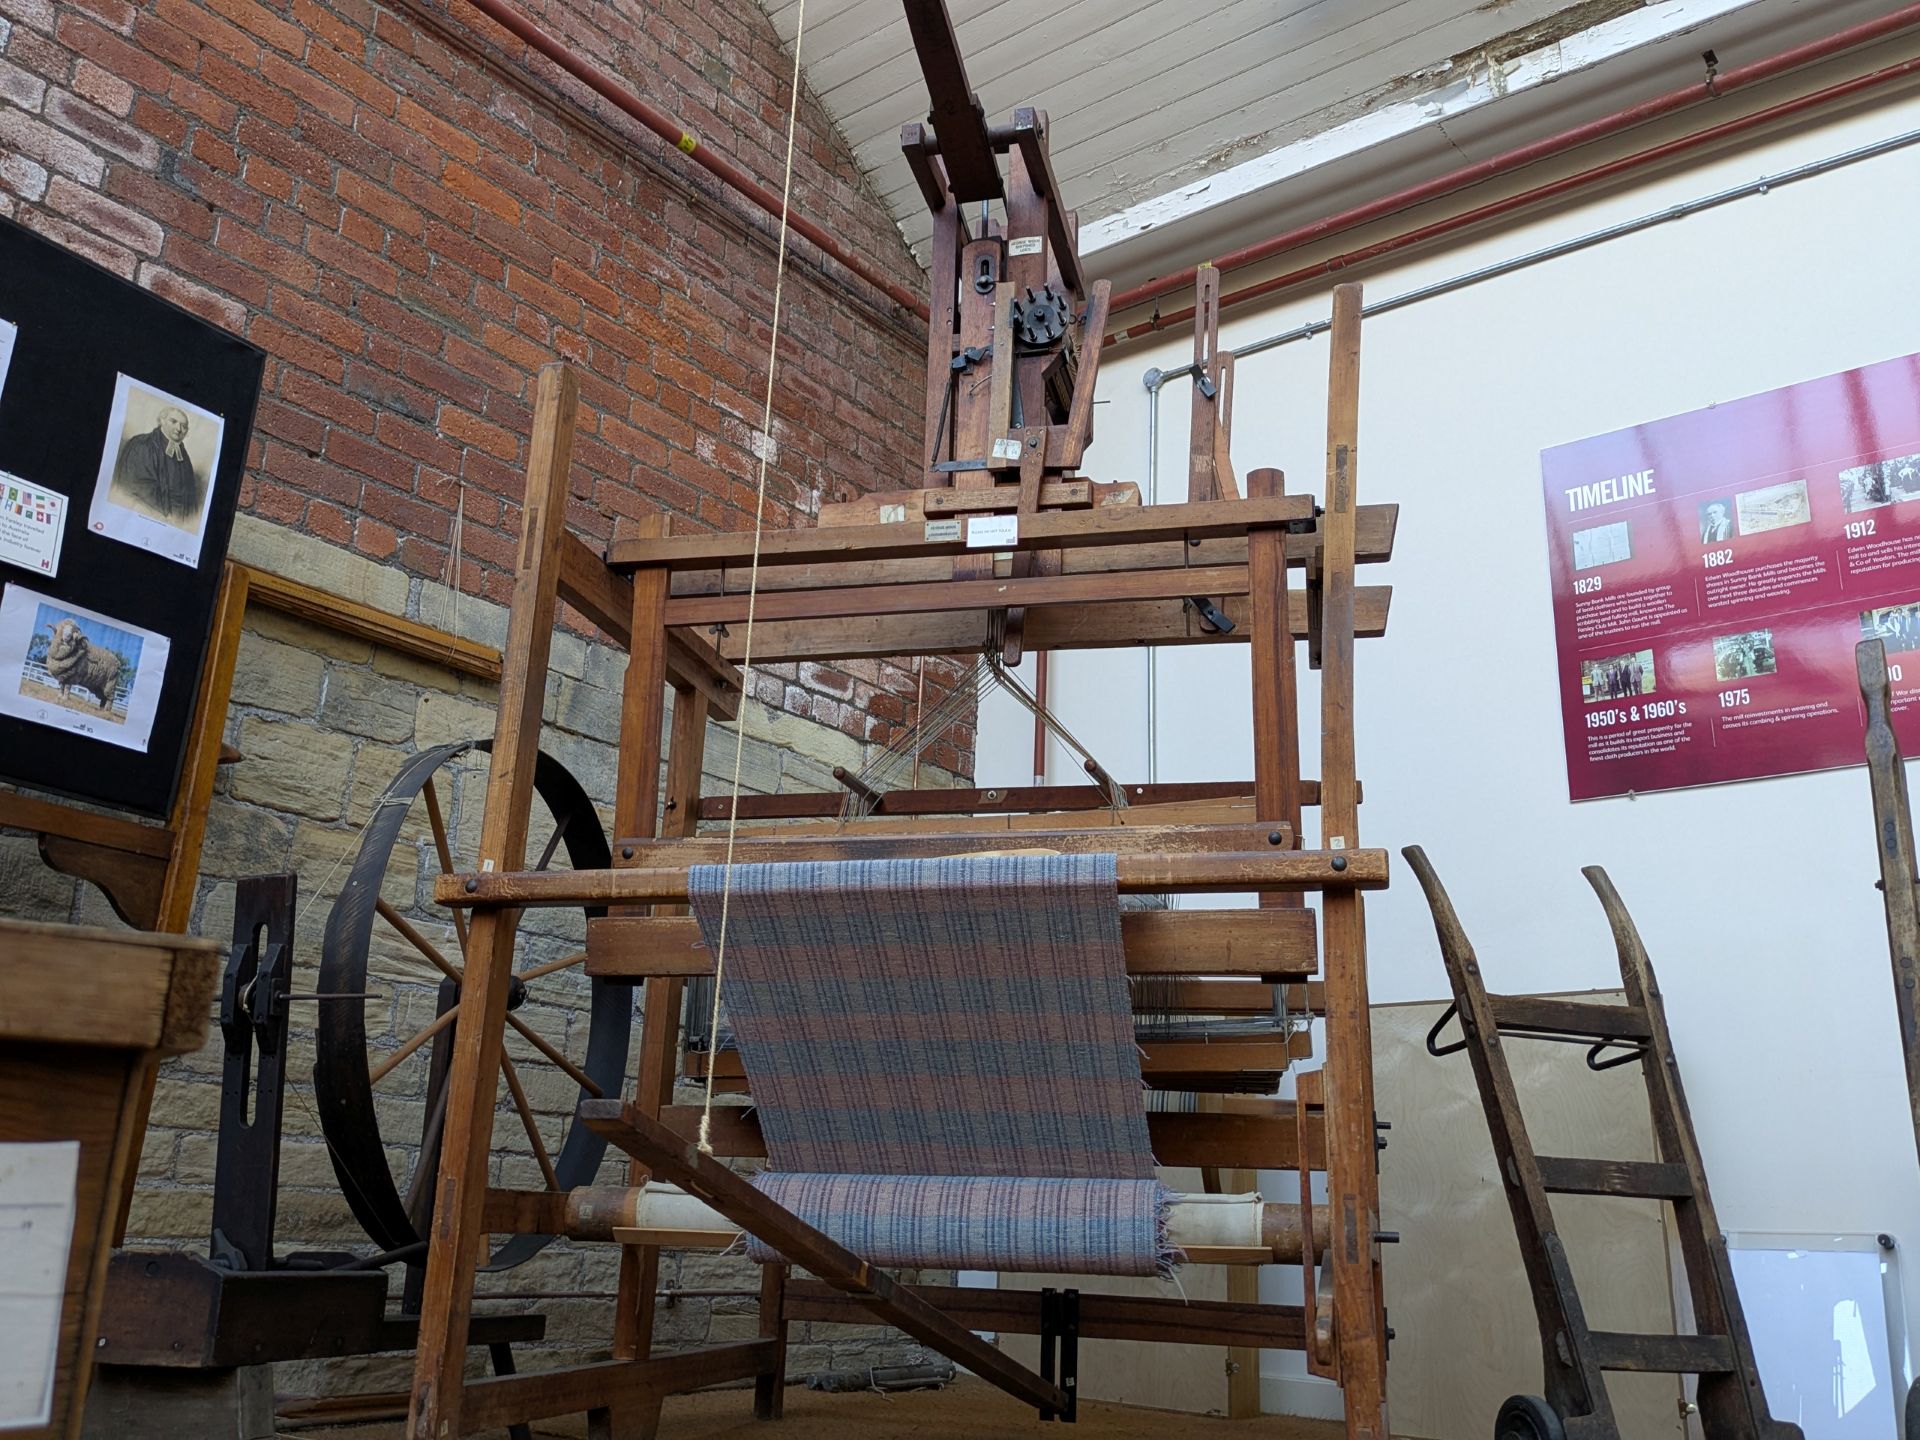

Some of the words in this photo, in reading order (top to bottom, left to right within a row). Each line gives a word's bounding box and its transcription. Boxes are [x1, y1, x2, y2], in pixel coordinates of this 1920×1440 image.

[1565, 469, 1656, 512] TIMELINE
[1844, 519, 1876, 539] 1912
[1702, 548, 1734, 568] 1882
[1705, 574, 1722, 582] Edwin
[1722, 568, 1755, 578] Woodhouse
[1755, 562, 1783, 572] purchases
[1794, 555, 1819, 564] majority
[1573, 576, 1602, 595] 1829
[1718, 688, 1750, 708] 1975
[1585, 708, 1627, 728] 1950's
[1630, 706, 1640, 721] &
[1642, 700, 1687, 719] 1960's
